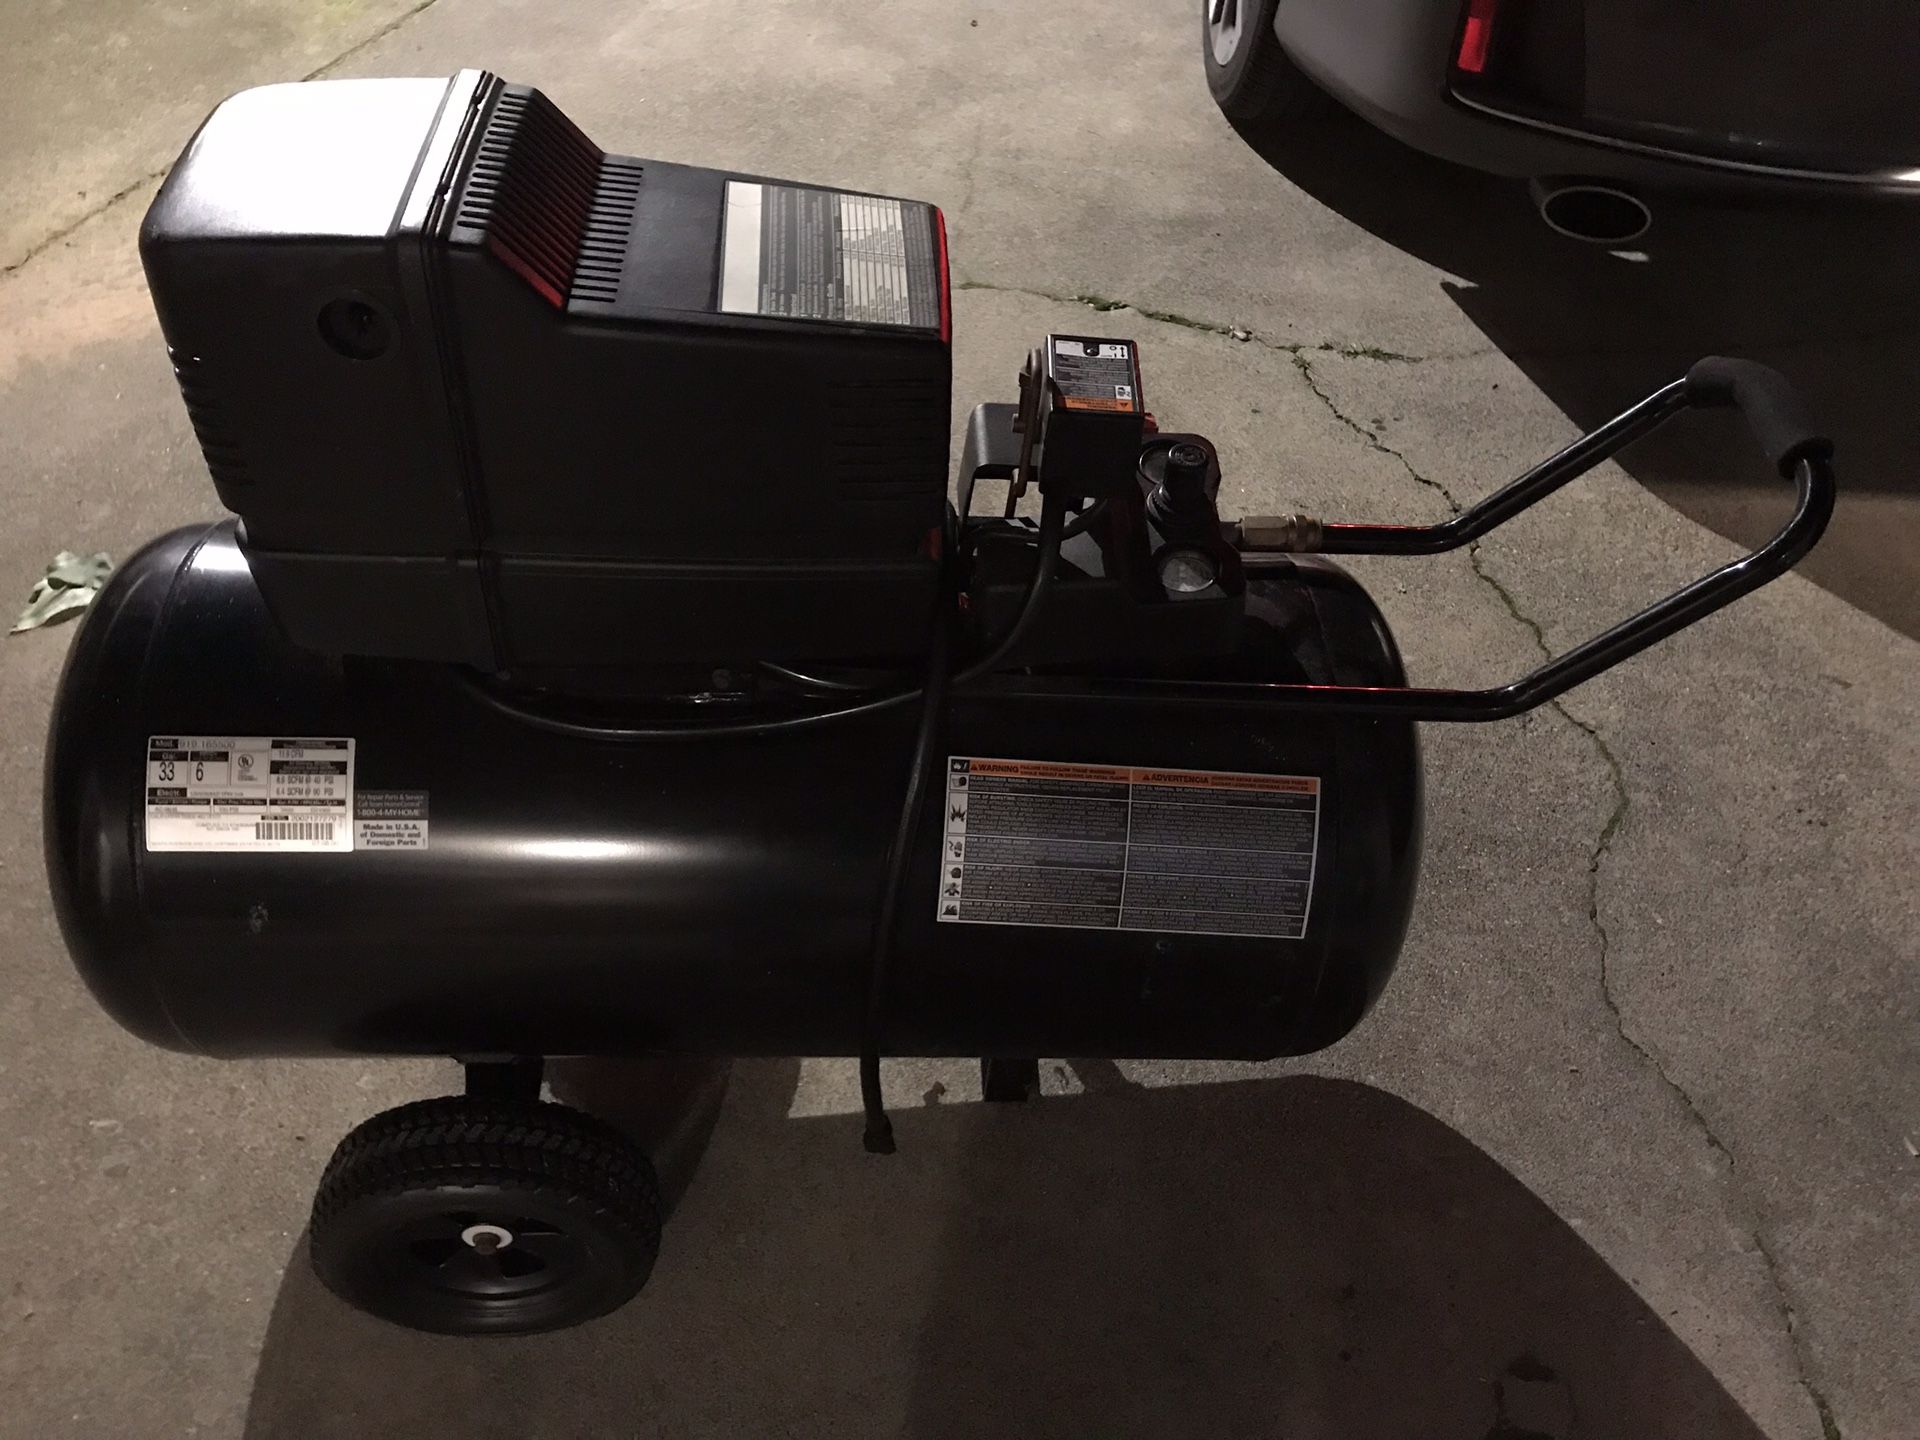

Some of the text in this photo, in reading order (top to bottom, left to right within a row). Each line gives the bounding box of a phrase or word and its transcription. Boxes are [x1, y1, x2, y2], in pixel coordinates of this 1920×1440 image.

[159, 761, 175, 781] 33
[196, 761, 204, 781] 6
[979, 764, 1019, 773] WARNING
[1151, 773, 1209, 784] ADVERTENCIA
